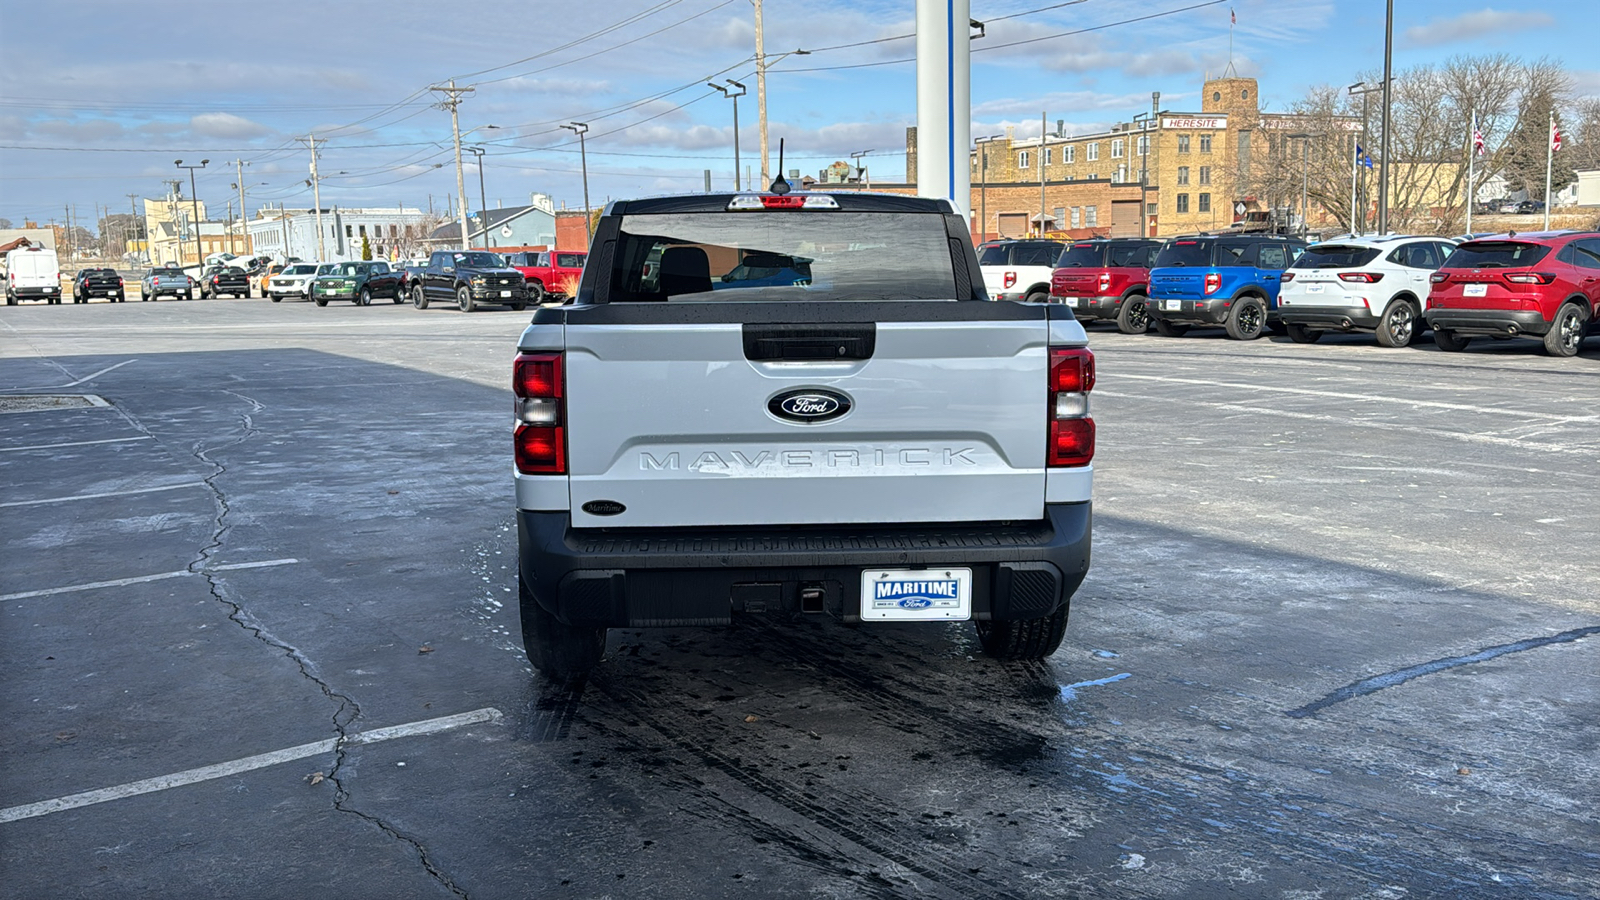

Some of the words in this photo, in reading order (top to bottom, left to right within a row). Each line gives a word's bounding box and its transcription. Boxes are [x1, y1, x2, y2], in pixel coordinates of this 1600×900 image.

[1169, 119, 1218, 128] HERESITE
[792, 397, 828, 413] Ford
[638, 447, 977, 471] MAVERICK
[587, 503, 622, 512] Maritime
[877, 581, 957, 599] MARITIME
[903, 599, 927, 608] Ford
